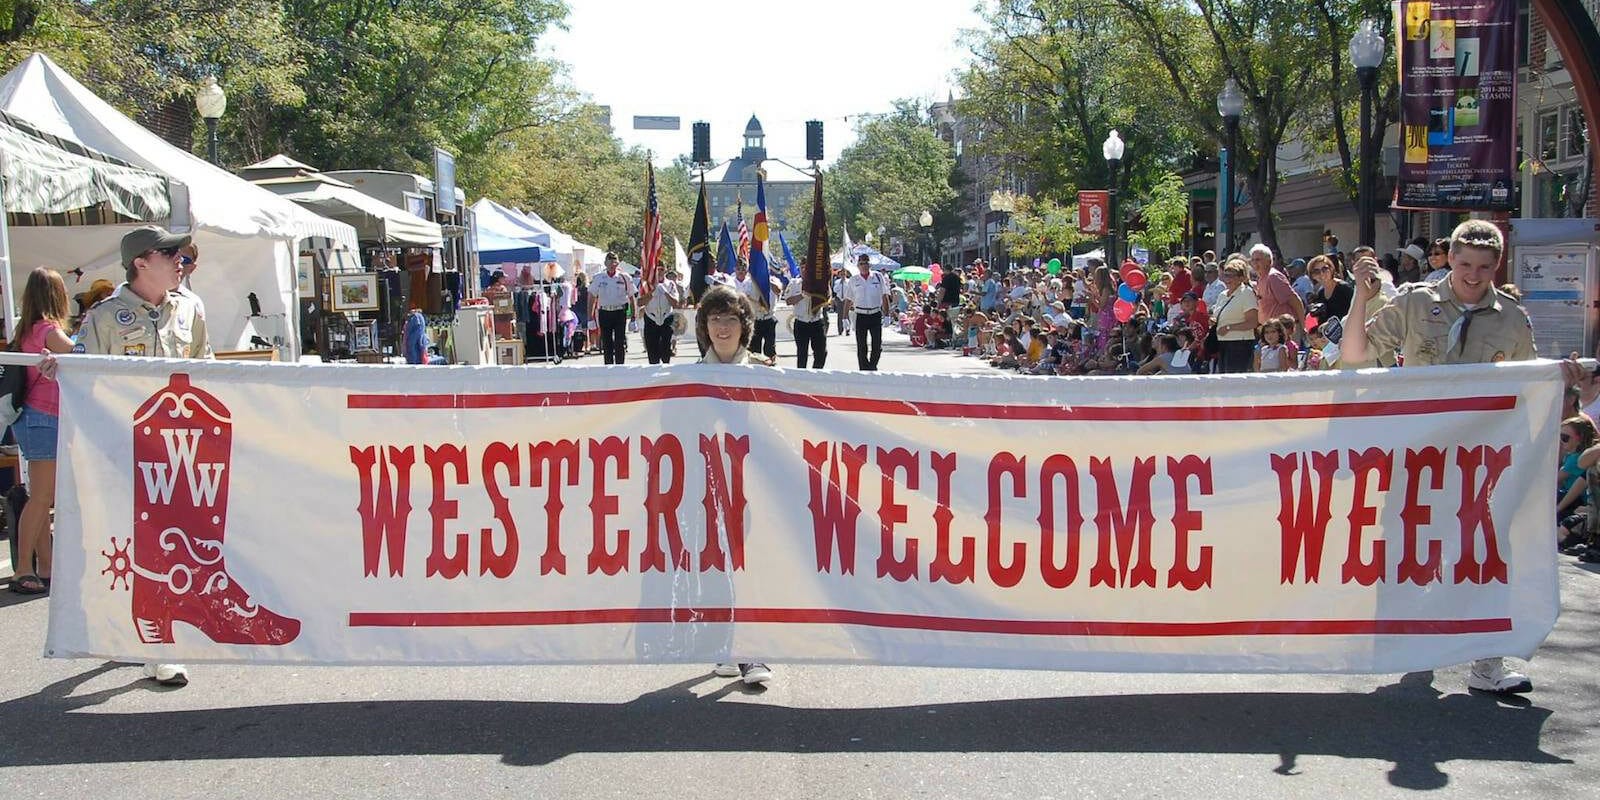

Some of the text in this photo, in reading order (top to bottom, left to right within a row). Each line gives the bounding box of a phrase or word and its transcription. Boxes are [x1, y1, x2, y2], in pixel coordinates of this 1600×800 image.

[1480, 92, 1512, 100] SEASON
[349, 432, 1513, 591] WESTERN WELCOME WEEK
